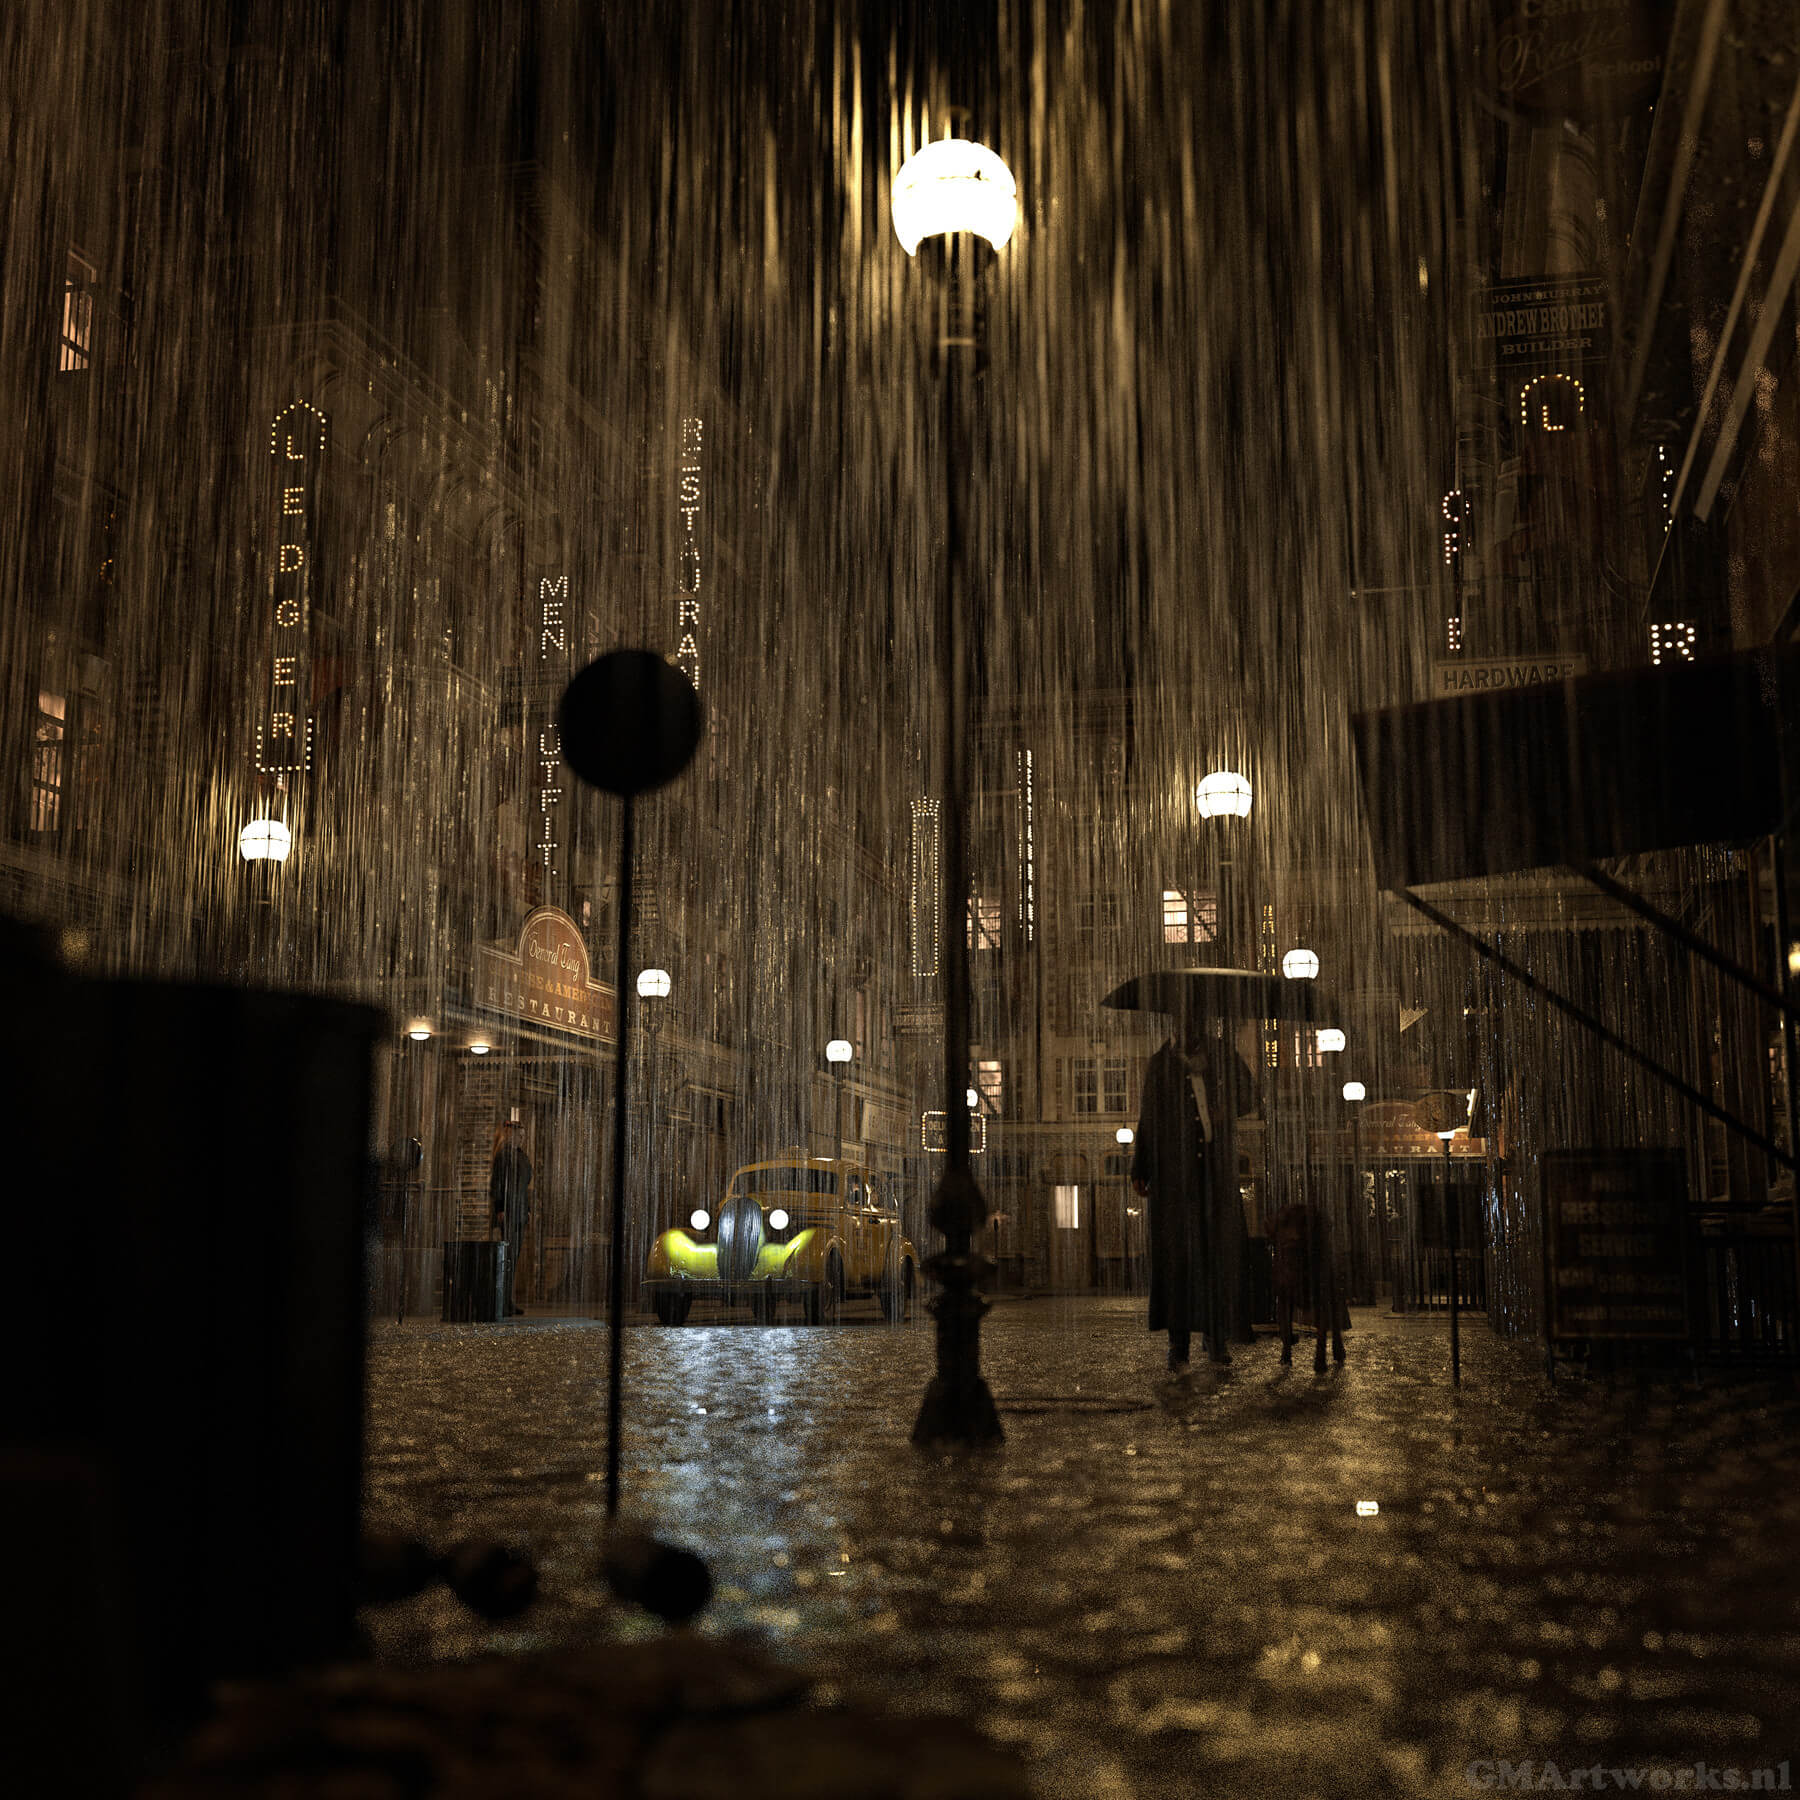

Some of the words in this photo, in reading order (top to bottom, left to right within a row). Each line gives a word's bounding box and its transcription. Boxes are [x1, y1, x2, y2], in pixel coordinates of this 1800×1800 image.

[1502, 337, 1593, 355] BUILDER
[677, 416, 703, 691] RESTAURAN
[272, 434, 305, 738] LEDGER
[1443, 662, 1577, 690] HARDWARE
[488, 986, 611, 1034] RESTAURANT
